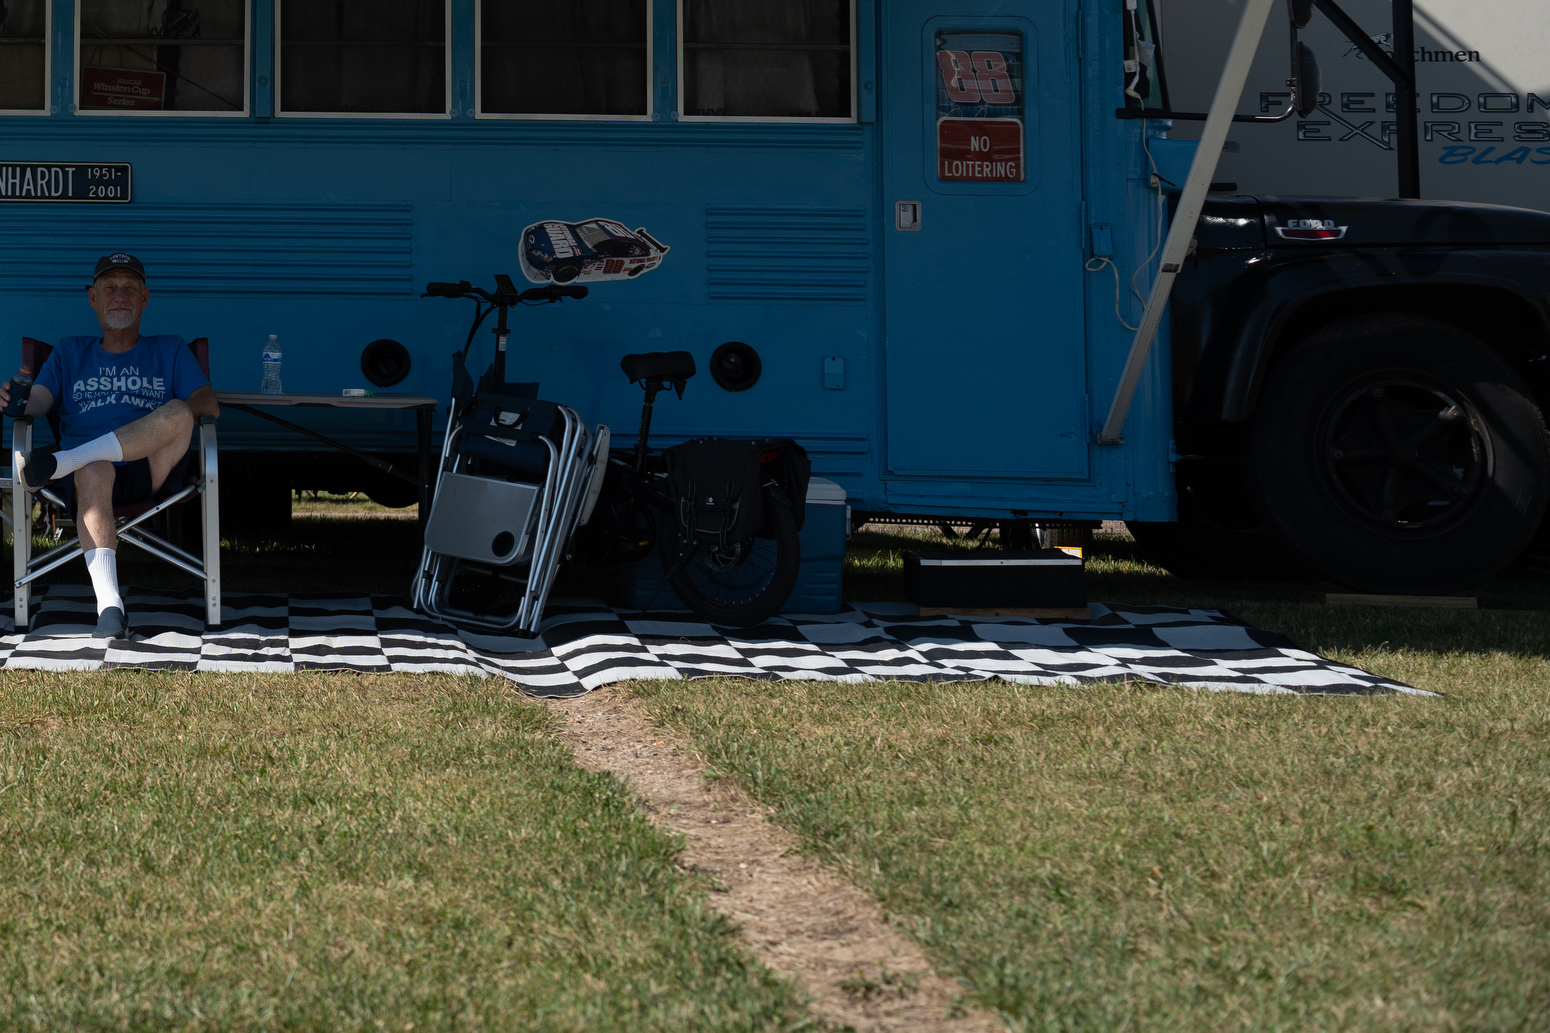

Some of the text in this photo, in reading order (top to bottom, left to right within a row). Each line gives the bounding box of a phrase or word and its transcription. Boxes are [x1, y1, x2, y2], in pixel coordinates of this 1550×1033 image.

[936, 50, 1016, 104] 88
[93, 82, 151, 96] Winston Cup
[106, 96, 136, 106] Series
[970, 135, 991, 153] NO
[87, 167, 122, 180] 1951-
[944, 160, 1017, 178] LOITERING
[88, 185, 121, 198] 2001
[1287, 219, 1335, 229] FORD
[603, 258, 625, 275] 88
[99, 366, 139, 376] I'M AN
[73, 376, 166, 393] ASSHOLE
[72, 392, 82, 402] SO
[141, 388, 166, 399] WANT
[120, 394, 155, 410] AWA
